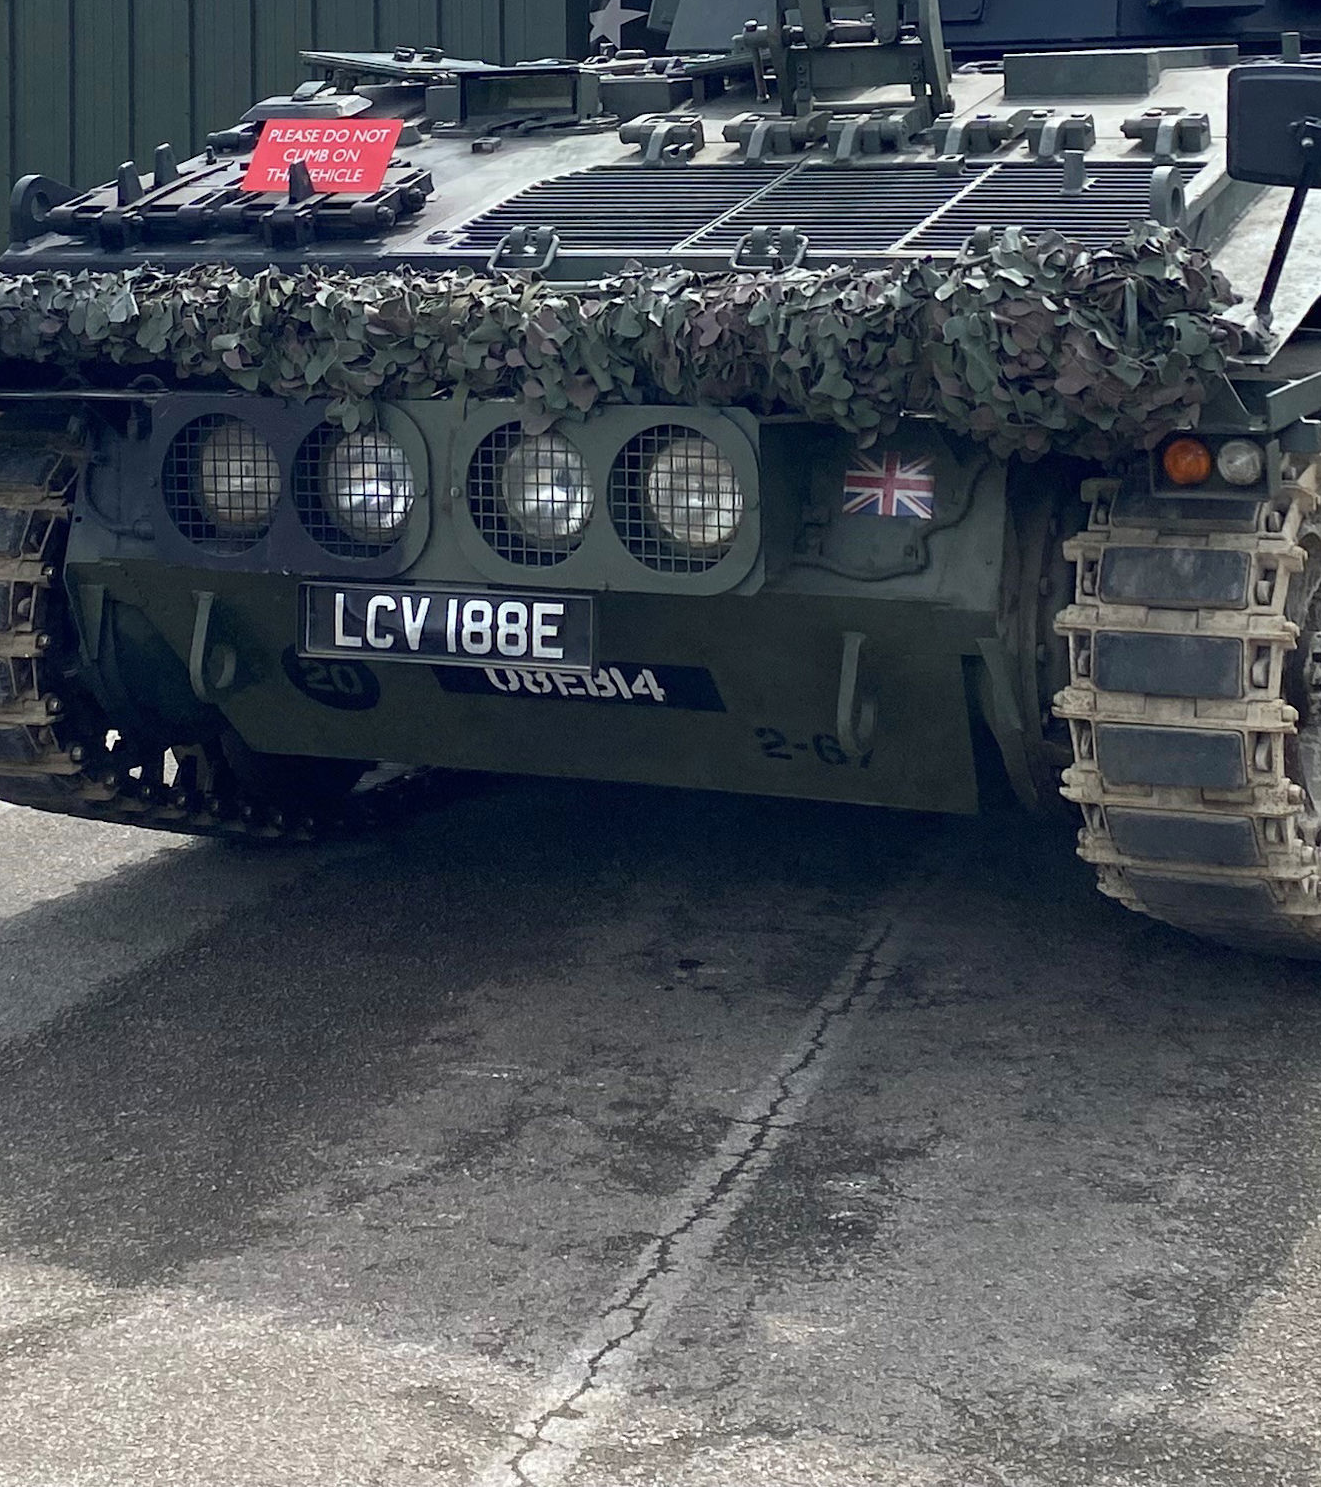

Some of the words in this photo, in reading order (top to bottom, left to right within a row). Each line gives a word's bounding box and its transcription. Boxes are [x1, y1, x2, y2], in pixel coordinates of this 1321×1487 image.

[268, 129, 321, 143] PLEASE
[322, 129, 350, 143] DO
[352, 129, 391, 143] NOT
[283, 148, 329, 163] CLIMB
[332, 149, 361, 163] ON
[267, 168, 289, 182] TH
[334, 592, 431, 651] LCV
[446, 598, 565, 659] 188E
[753, 726, 875, 769] 2-6
